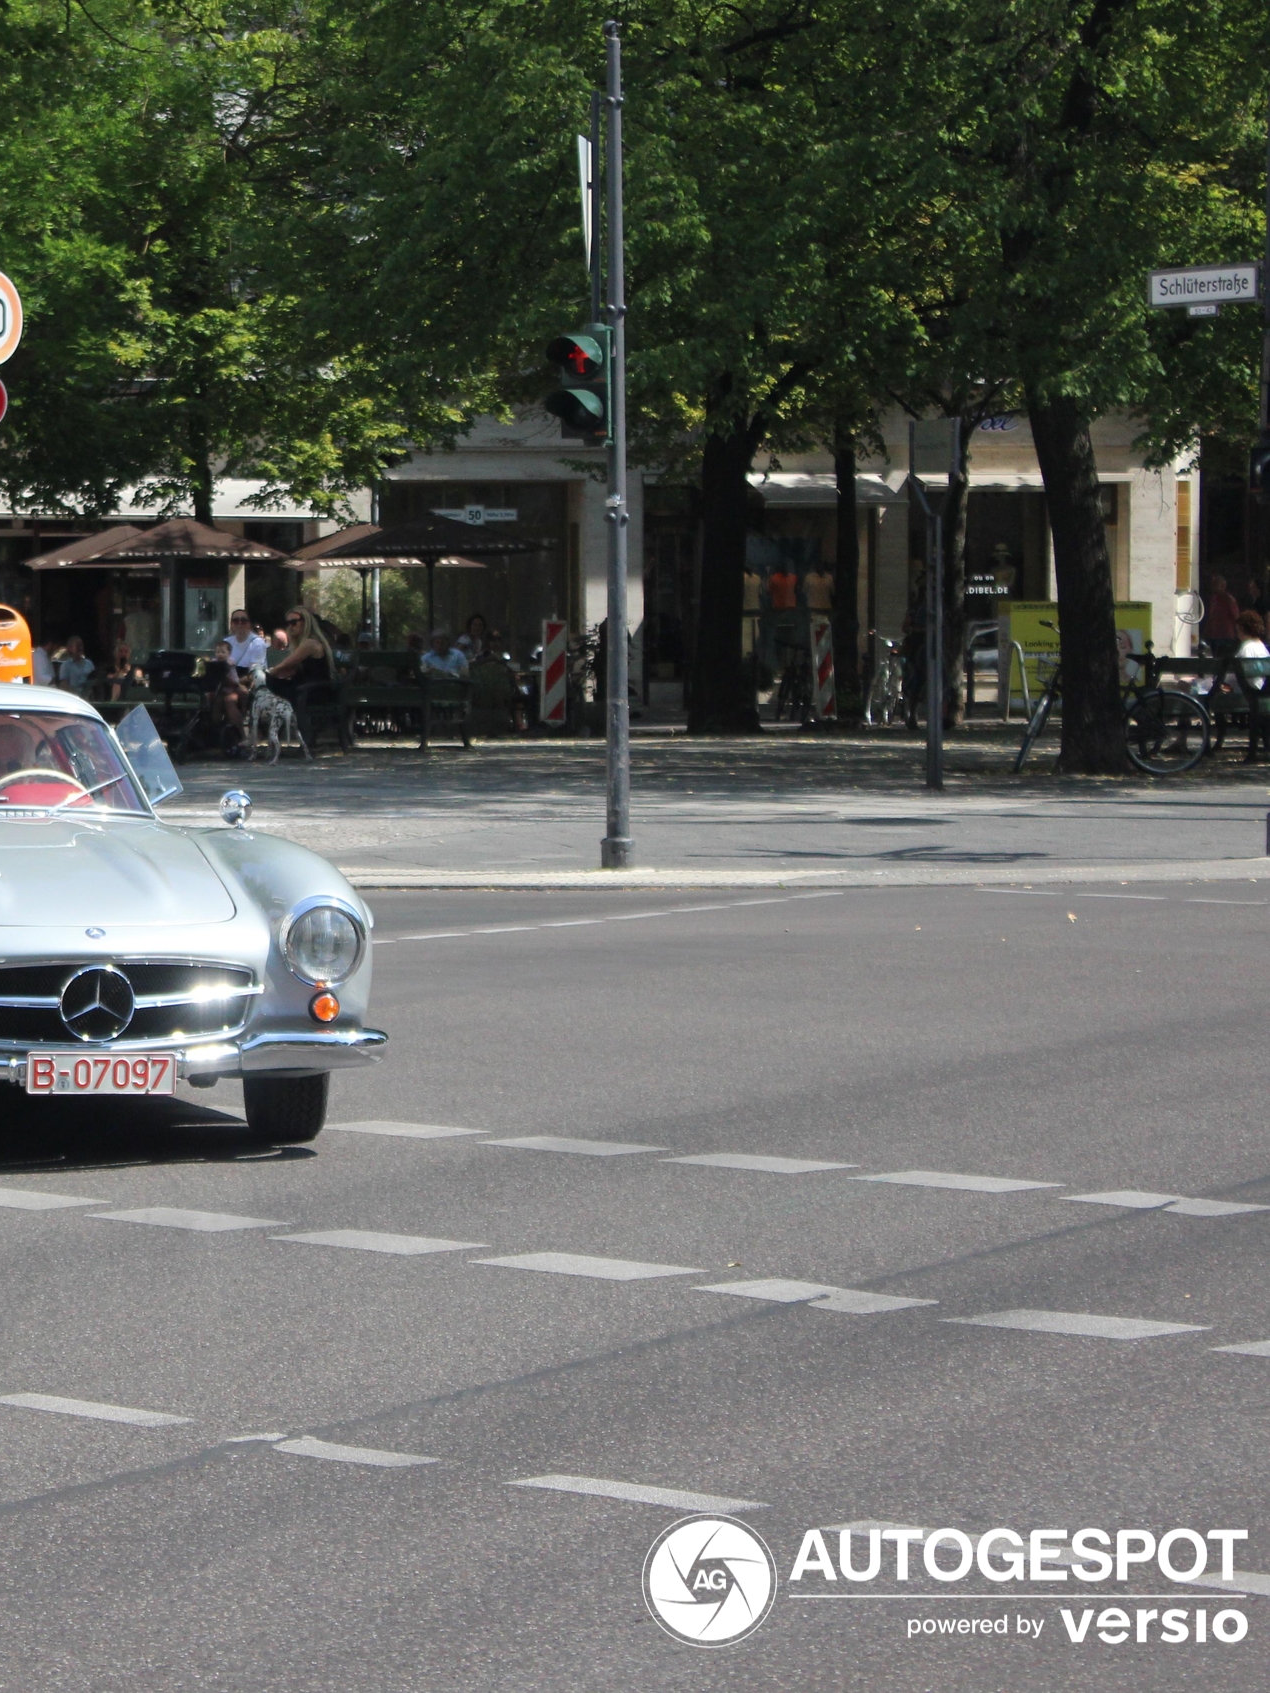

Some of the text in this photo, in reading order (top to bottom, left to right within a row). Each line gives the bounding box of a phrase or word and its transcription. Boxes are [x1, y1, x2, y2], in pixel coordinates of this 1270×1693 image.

[1160, 274, 1249, 296] Schlüterstraße
[468, 510, 481, 520] 50
[318, 557, 459, 567] EINSTEIN KAEE
[966, 587, 1009, 595] .DIBEL.DE
[1025, 641, 1054, 650] Looking
[33, 1058, 170, 1089] B-07097
